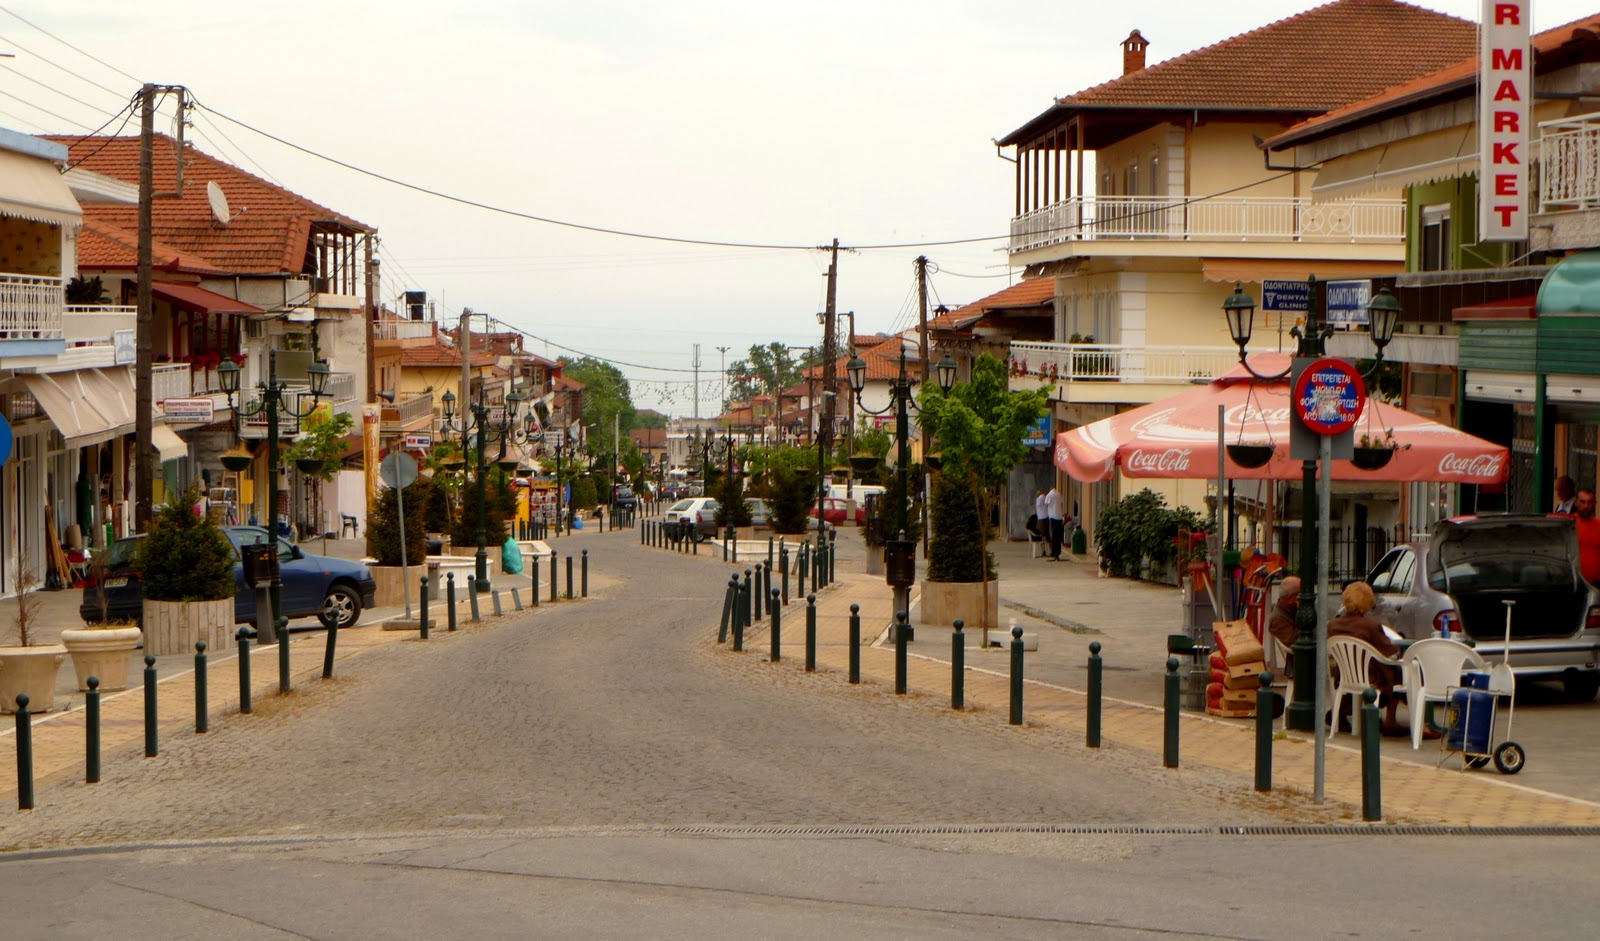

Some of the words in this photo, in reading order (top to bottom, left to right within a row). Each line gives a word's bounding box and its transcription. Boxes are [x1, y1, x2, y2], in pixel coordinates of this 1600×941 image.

[1491, 48, 1523, 228] MARKET
[1127, 448, 1192, 472] Coca-Cola
[1438, 452, 1504, 477] Coca-Cola
